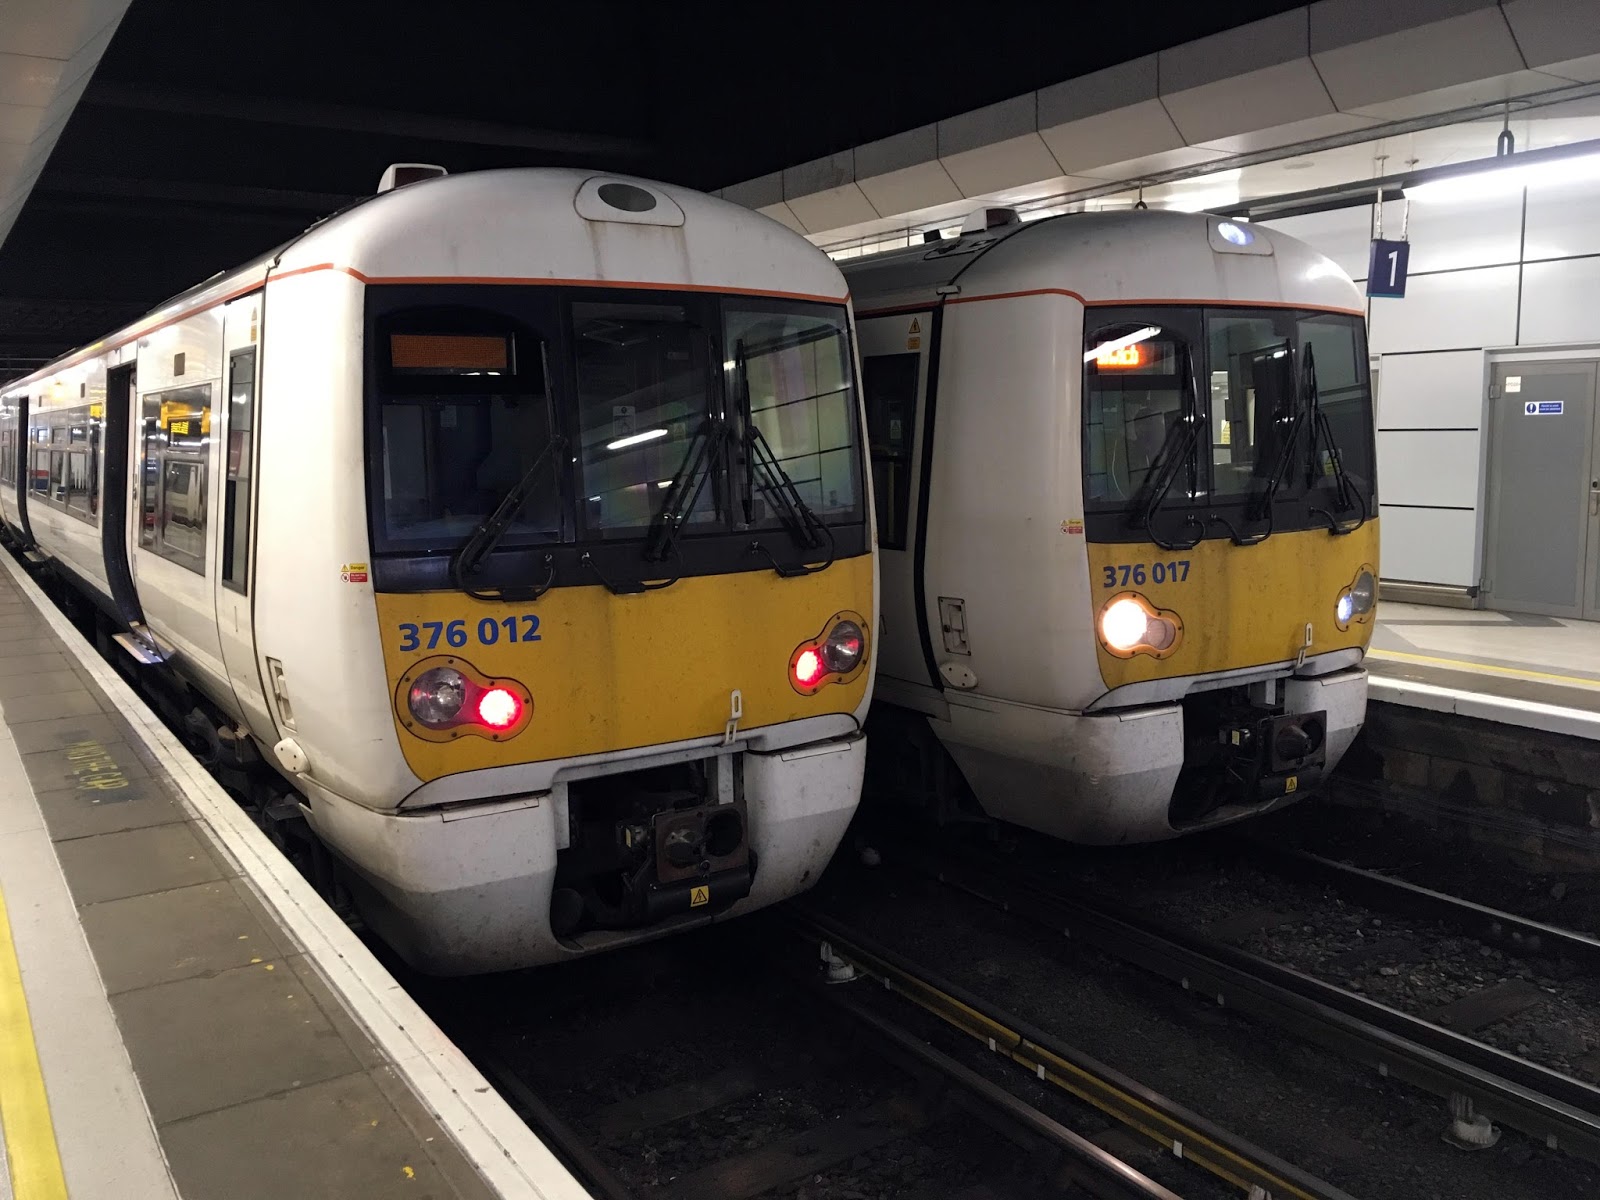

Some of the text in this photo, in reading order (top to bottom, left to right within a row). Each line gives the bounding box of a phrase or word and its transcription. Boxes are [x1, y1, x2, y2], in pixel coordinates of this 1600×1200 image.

[1388, 250, 1398, 287] 1
[1103, 560, 1190, 588] 376 017
[398, 614, 542, 652] 376 012
